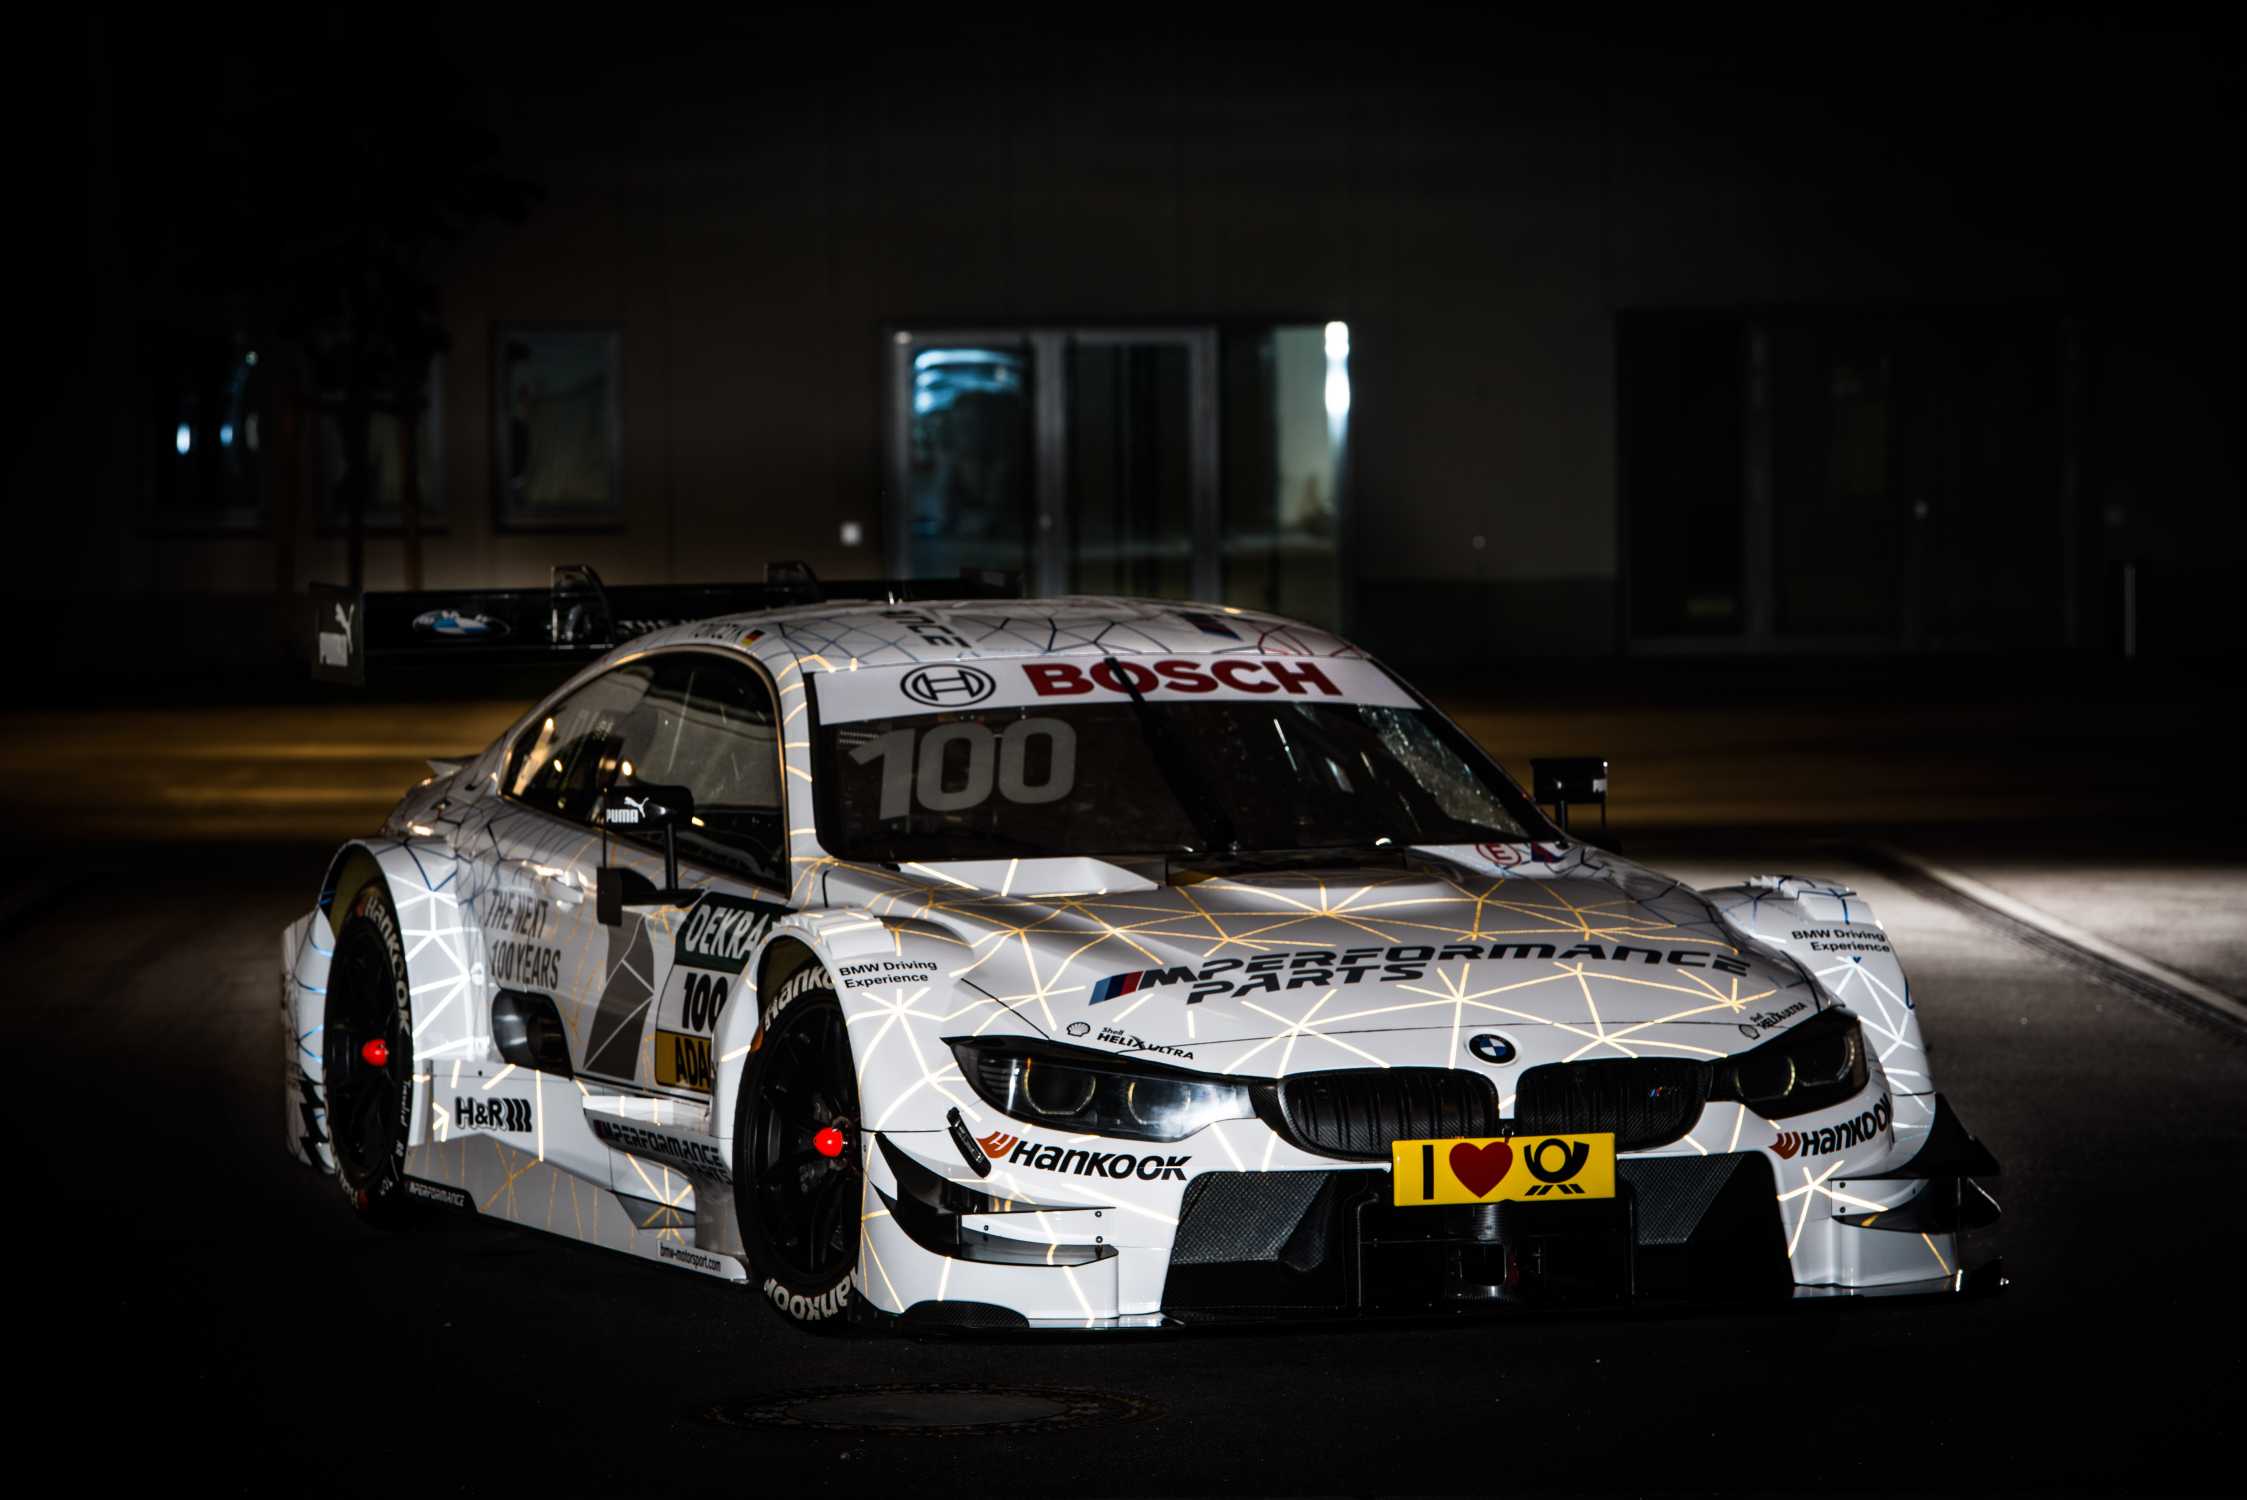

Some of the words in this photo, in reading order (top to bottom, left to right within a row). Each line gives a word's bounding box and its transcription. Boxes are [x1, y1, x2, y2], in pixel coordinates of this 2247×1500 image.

[1022, 660, 1343, 696] BOSCH
[848, 716, 1078, 820] 100
[605, 807, 640, 825] PUMA
[484, 888, 514, 932] THE
[511, 893, 548, 940] NEXT
[684, 903, 770, 961] DEKRA
[1792, 929, 1830, 940] BMW
[1834, 929, 1886, 942] Driving
[1811, 941, 1890, 953] Experience
[517, 943, 562, 991] YEARS
[839, 963, 880, 976] BMW
[884, 960, 938, 971] Driving
[844, 973, 929, 989] Experience
[1199, 944, 1751, 981] PERFORMANCE
[682, 972, 728, 1032] 100
[762, 964, 836, 1032] Hanko
[1187, 962, 1426, 1005] PARTS
[675, 1036, 712, 1088] ADA
[1097, 1033, 1146, 1050] HELIX
[1149, 1043, 1194, 1060] ULTRA
[456, 1097, 503, 1126] H&R
